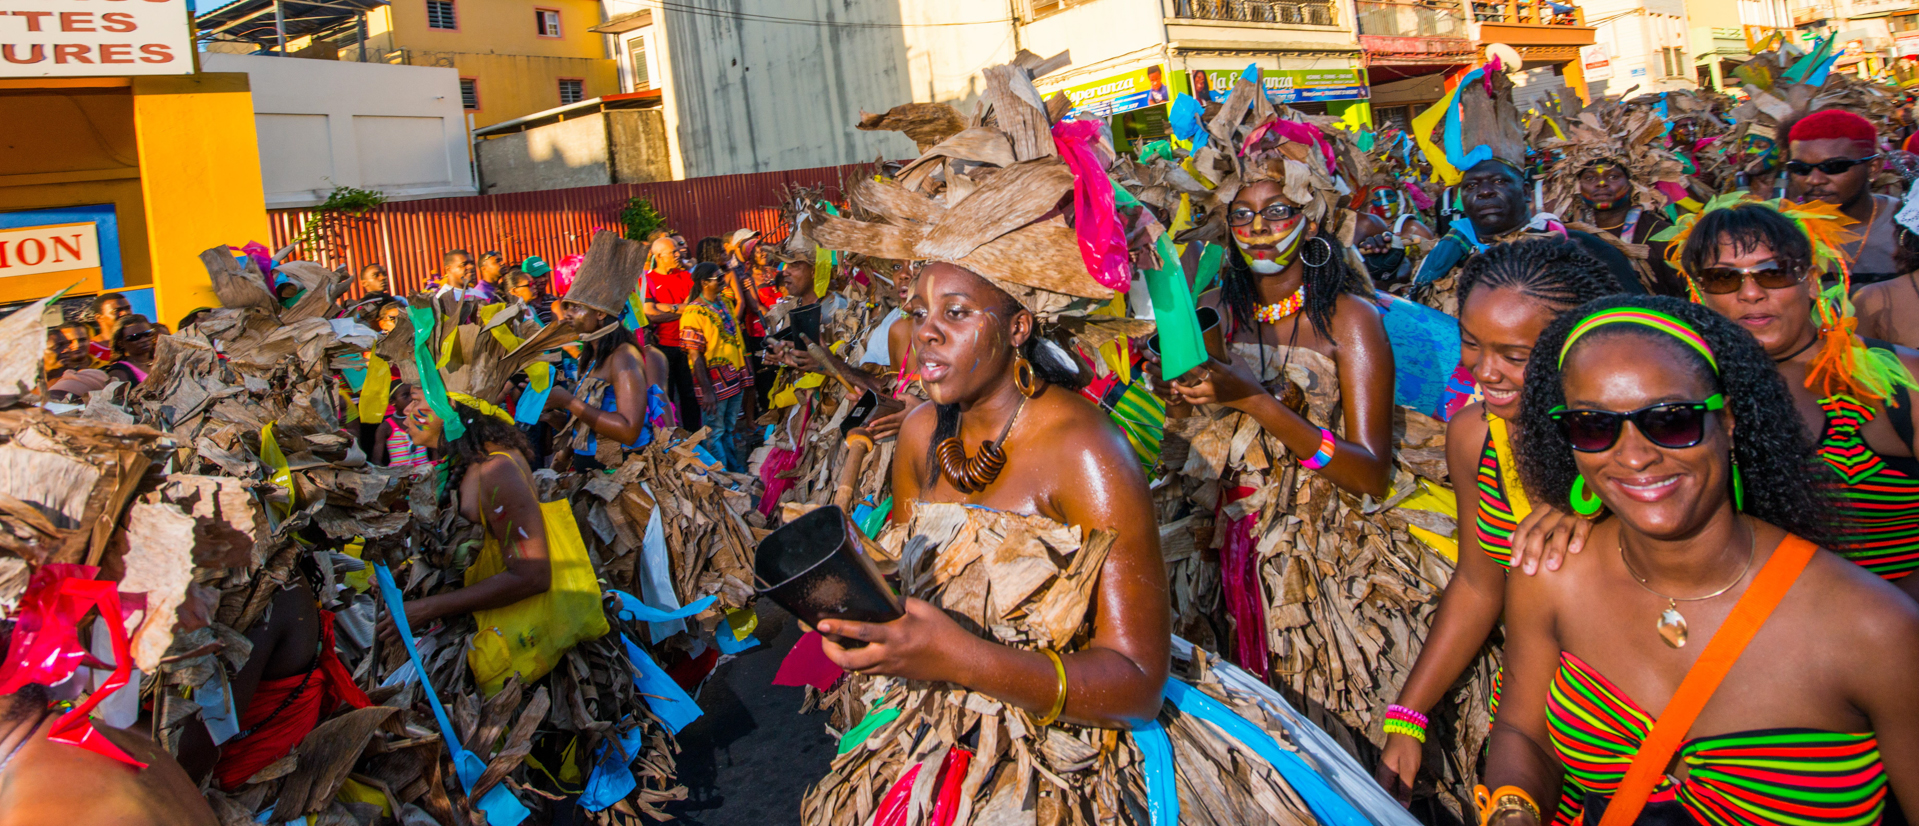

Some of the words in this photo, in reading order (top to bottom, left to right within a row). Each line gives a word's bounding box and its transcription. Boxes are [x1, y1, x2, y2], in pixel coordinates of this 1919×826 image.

[0, 11, 137, 33] TES
[2, 43, 174, 64] URES
[1209, 72, 1226, 94] La
[1229, 72, 1293, 88] Eanza
